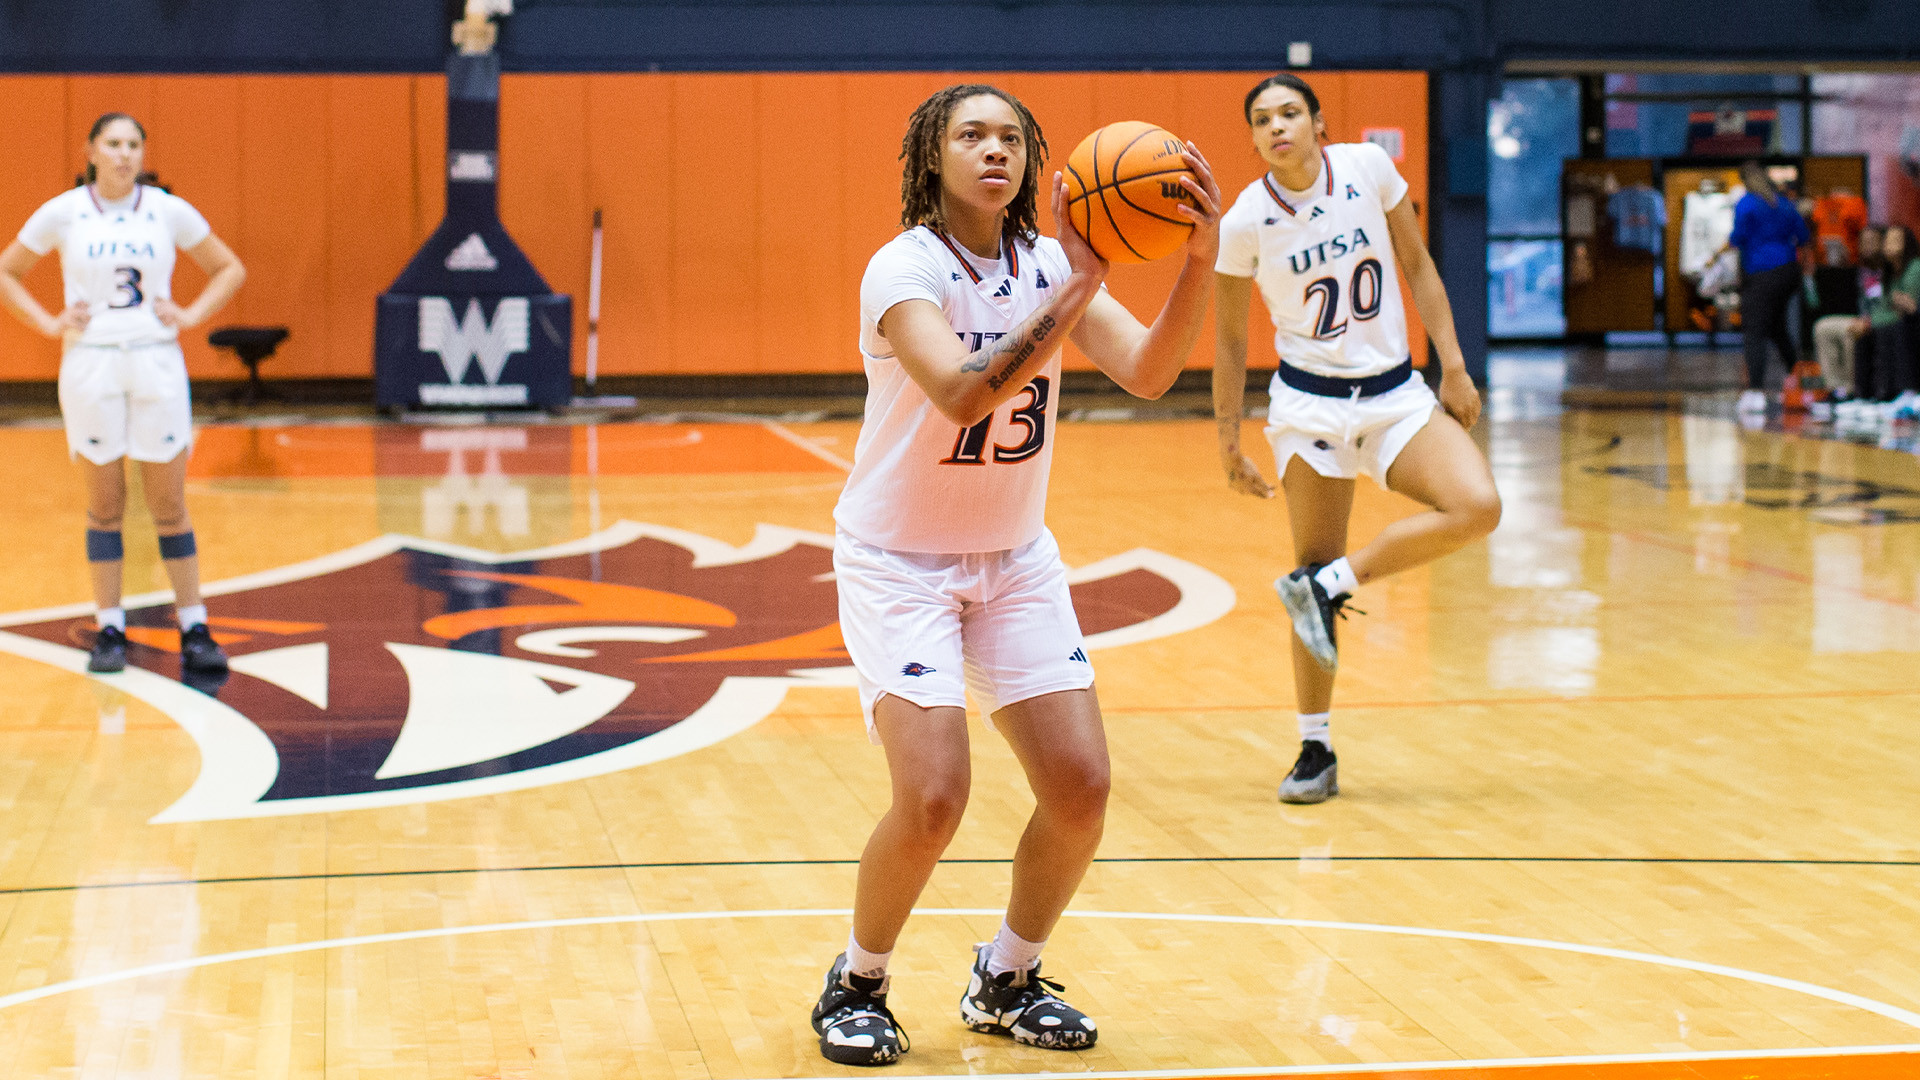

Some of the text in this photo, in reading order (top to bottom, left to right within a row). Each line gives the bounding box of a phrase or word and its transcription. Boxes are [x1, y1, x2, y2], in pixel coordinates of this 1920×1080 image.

[108, 267, 143, 309] 3
[1287, 228, 1371, 275] UTSA
[1303, 258, 1383, 341] 20
[986, 314, 1056, 393] Romans 8:18
[938, 374, 1051, 466] 13
